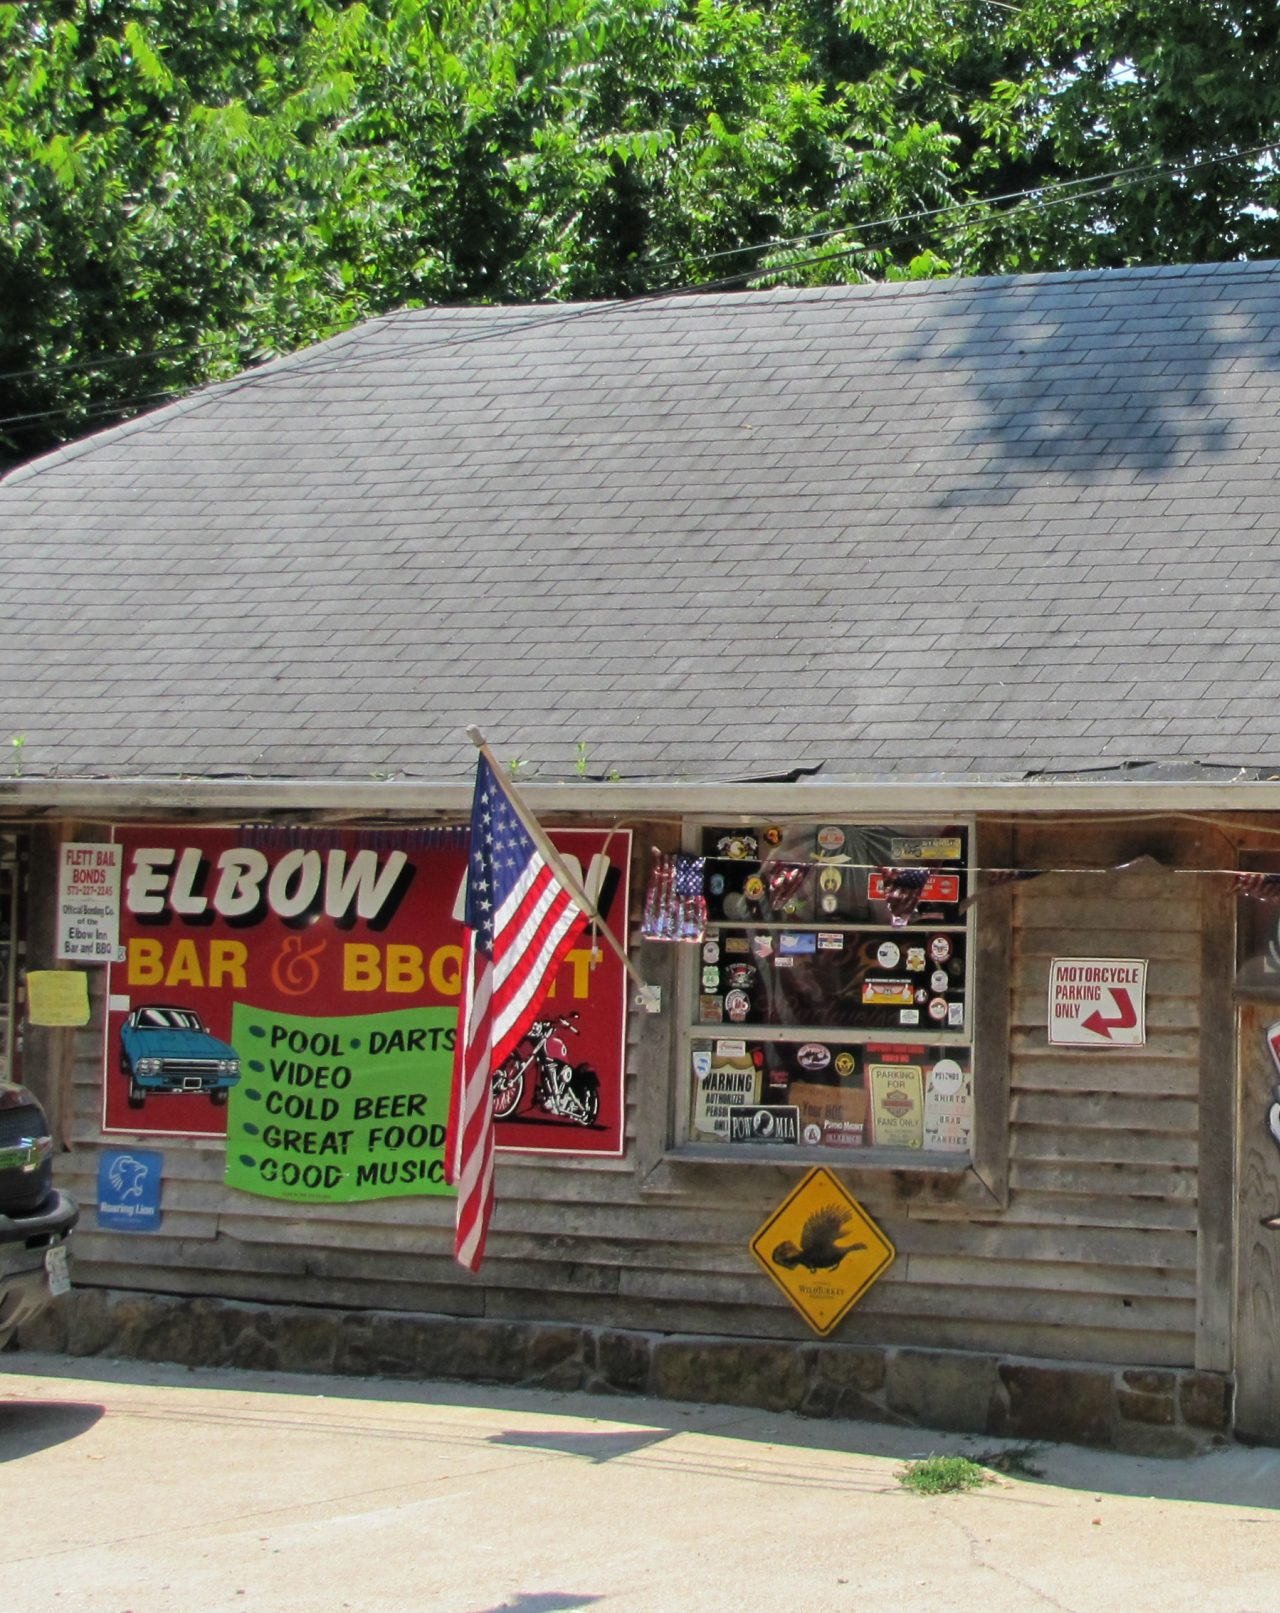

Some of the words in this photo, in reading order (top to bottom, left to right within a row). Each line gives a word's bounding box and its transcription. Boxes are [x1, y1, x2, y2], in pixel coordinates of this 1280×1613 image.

[66, 850, 93, 866] FLETT
[96, 851, 116, 866] BAIL
[73, 869, 106, 884] BONDS
[127, 847, 410, 922] ELBOW
[69, 927, 93, 939] Elbow
[96, 928, 107, 940] Inn
[64, 941, 79, 953] Bar
[80, 942, 93, 953] and
[95, 943, 111, 955] BBQ
[128, 938, 248, 988] BAR
[271, 936, 326, 995] &
[1056, 967, 1139, 983] MOTORCYCLE
[1056, 985, 1101, 1000] PARKING
[1055, 1003, 1080, 1018] ONLY
[271, 1025, 344, 1057] POOL
[369, 1028, 457, 1055] DARTS
[270, 1058, 352, 1089] VIDEO
[876, 1071, 914, 1080] PARKING
[702, 1073, 752, 1092] WARNING
[887, 1080, 905, 1088] FOR
[265, 1091, 339, 1121] COLD
[353, 1093, 427, 1120] BEER
[732, 1117, 752, 1137] POW
[775, 1117, 795, 1138] MIA
[876, 1118, 897, 1127] FANS
[899, 1119, 920, 1127] ONLY
[262, 1125, 354, 1155] GREAT
[368, 1124, 447, 1152] FOOD
[259, 1157, 344, 1189] GOOD
[356, 1159, 446, 1187] MUSIC
[101, 1202, 134, 1216] Roaring
[135, 1204, 154, 1215] Lion
